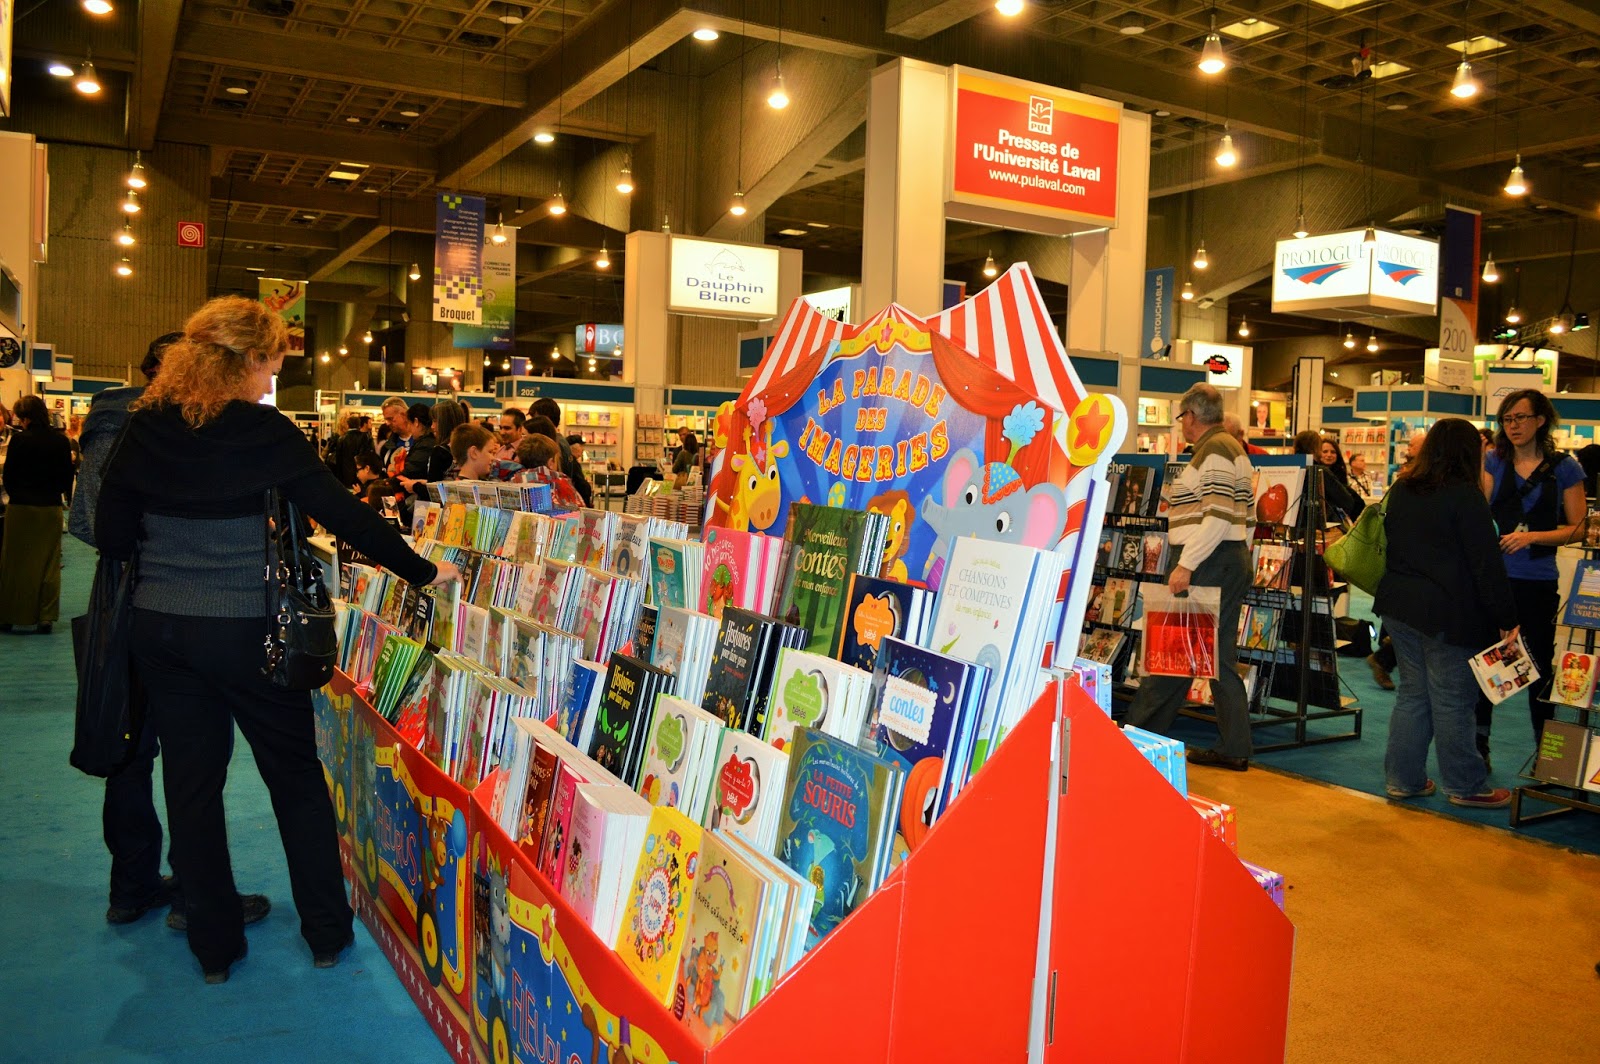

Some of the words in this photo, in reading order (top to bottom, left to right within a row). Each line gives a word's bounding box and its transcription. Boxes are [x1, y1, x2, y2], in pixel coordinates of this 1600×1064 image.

[1031, 123, 1050, 133] PUL
[998, 129, 1057, 156] Presses
[1061, 143, 1079, 160] de
[974, 143, 1058, 174] l'Université
[1063, 161, 1100, 182] Laval
[989, 170, 1085, 196] www.pulaval.com
[1282, 245, 1365, 268] PROLOGUE
[1377, 242, 1436, 269] PROLOGUE
[686, 278, 764, 294] Dauphin
[719, 273, 734, 281] Le
[700, 291, 750, 304] Blanc
[440, 306, 475, 321] Broquet
[1443, 328, 1467, 352] 200
[521, 388, 534, 397] 202
[817, 378, 846, 416] LA
[852, 366, 947, 420] PARADE
[855, 408, 888, 432] DES
[799, 417, 950, 482] IMAGERIES
[802, 528, 848, 548] Merveilleux
[802, 580, 814, 591] mon
[814, 582, 838, 598] enfance
[959, 569, 1008, 590] CHANSONS
[947, 584, 959, 597] ET
[959, 584, 1012, 610] COMPTINES
[724, 620, 752, 652] Histoires
[611, 664, 636, 697] Histoires
[792, 704, 806, 720] bébés
[890, 695, 924, 724] contes
[813, 769, 824, 784] LA
[826, 775, 853, 799] PETITE
[726, 790, 738, 806] bébé
[803, 780, 857, 829] SOURIS
[376, 798, 417, 886] FLEURUS
[698, 891, 710, 910] SUPER
[711, 907, 728, 930] GRANDE
